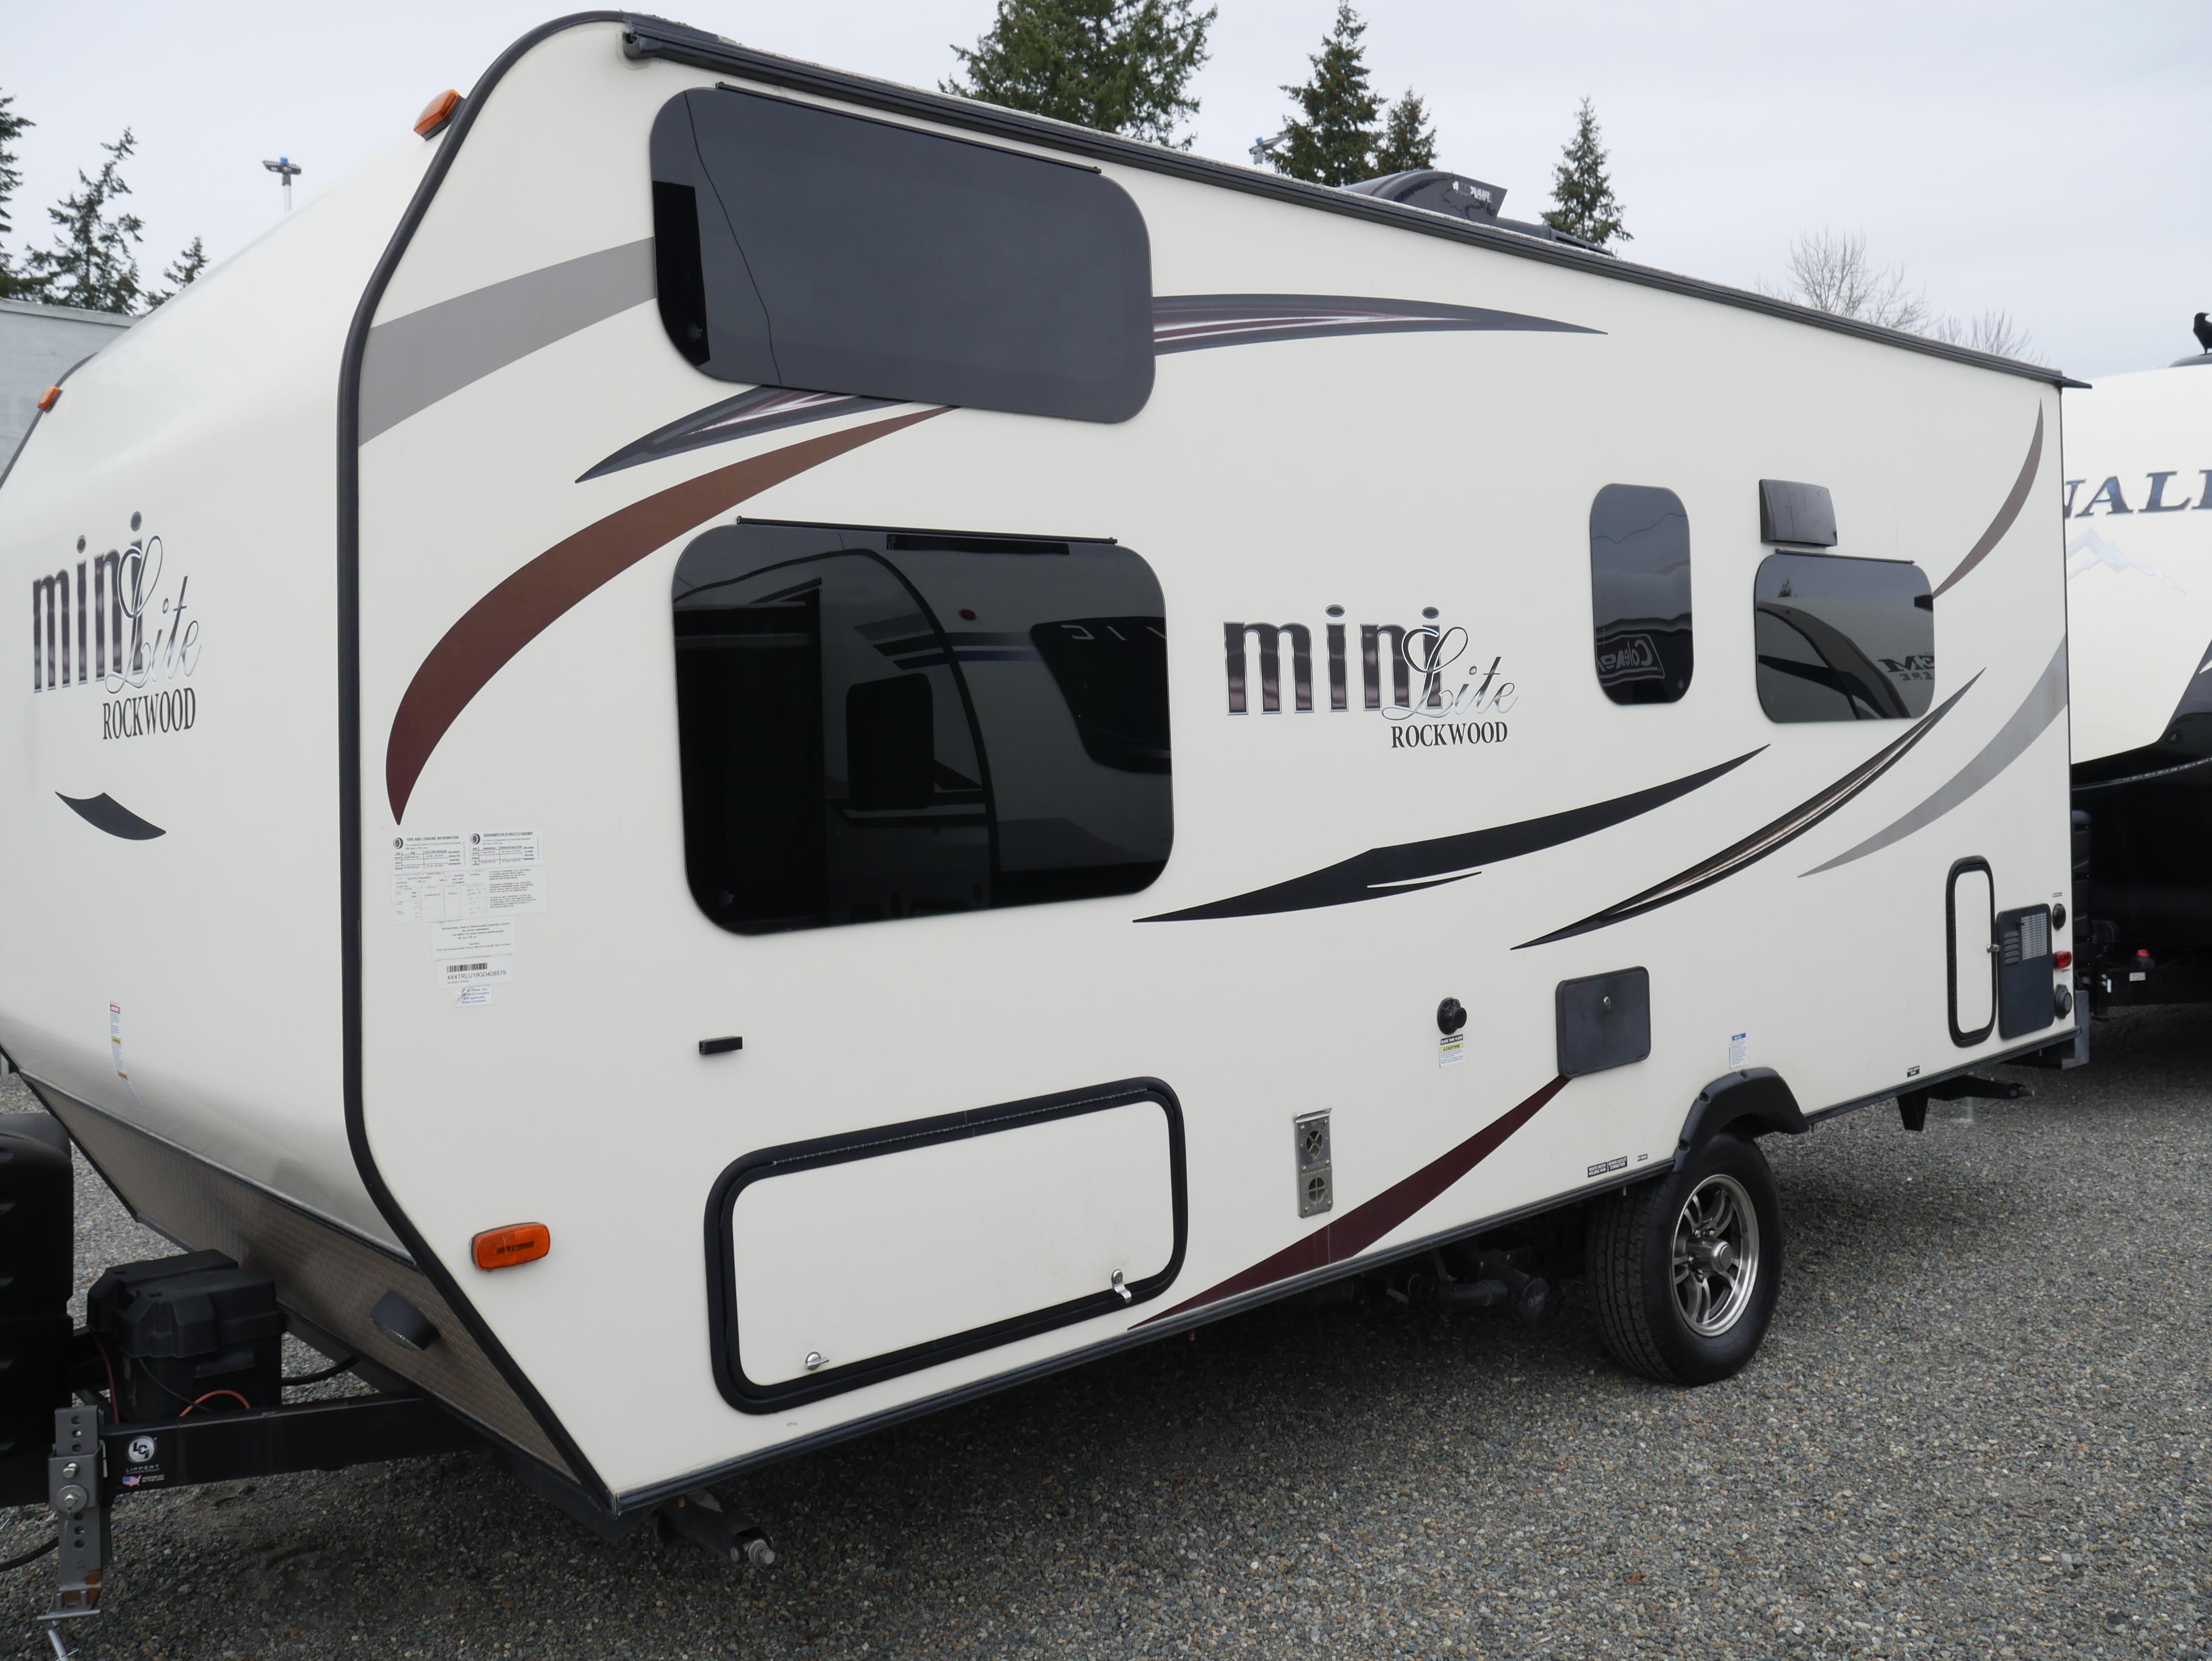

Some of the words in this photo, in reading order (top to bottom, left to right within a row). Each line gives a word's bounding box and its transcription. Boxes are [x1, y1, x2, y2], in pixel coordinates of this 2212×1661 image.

[32, 511, 143, 693] mini
[105, 535, 201, 694] Lite
[1223, 604, 1442, 716] mini
[1381, 626, 1518, 721] Lite
[103, 687, 196, 740] ROCKWOOD
[1391, 721, 1508, 748] ROCKWOOD
[447, 970, 506, 980] 4X4TRLU19GD408579
[126, 1464, 159, 1472] LIPPERT
